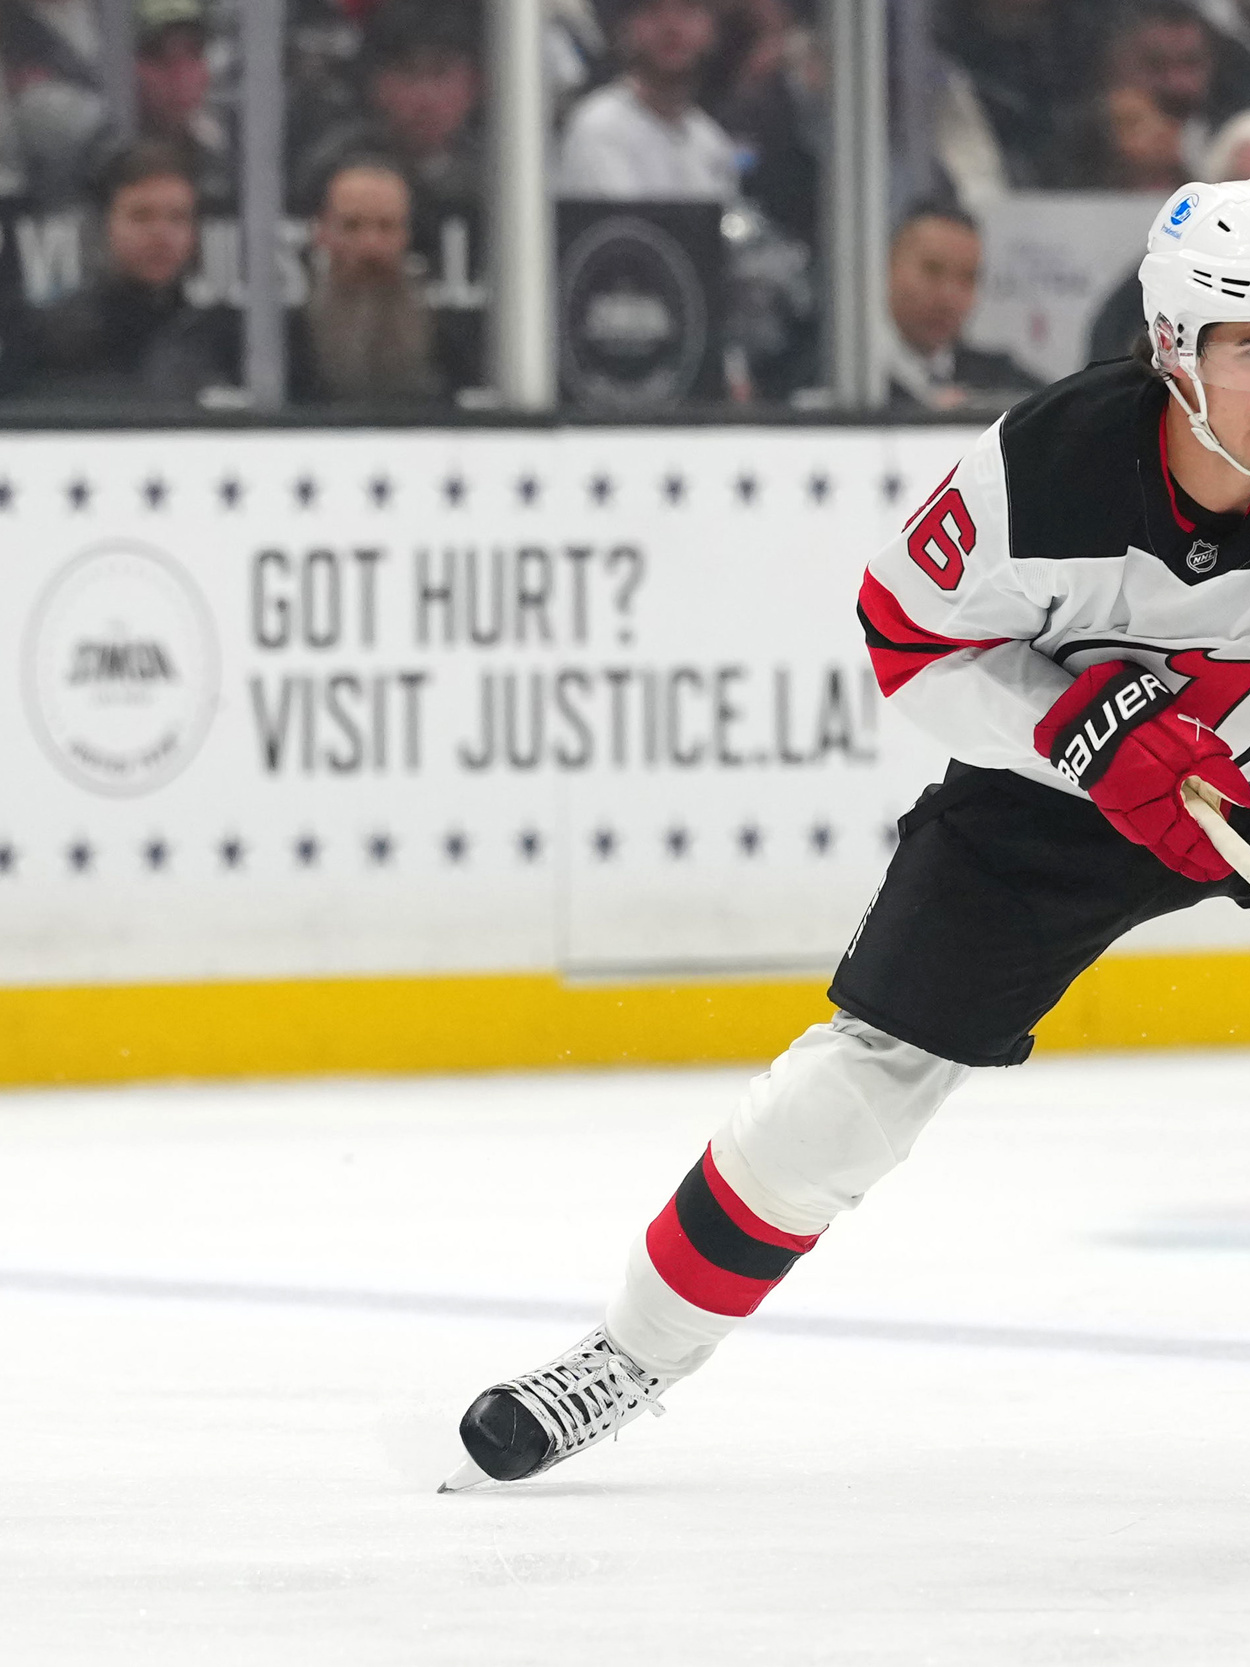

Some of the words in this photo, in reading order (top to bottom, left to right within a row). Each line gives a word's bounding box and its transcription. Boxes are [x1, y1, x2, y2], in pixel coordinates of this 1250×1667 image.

[901, 455, 977, 591] 6
[250, 547, 385, 649] GOT
[414, 544, 647, 647] HURT?
[247, 670, 431, 774] VISIT
